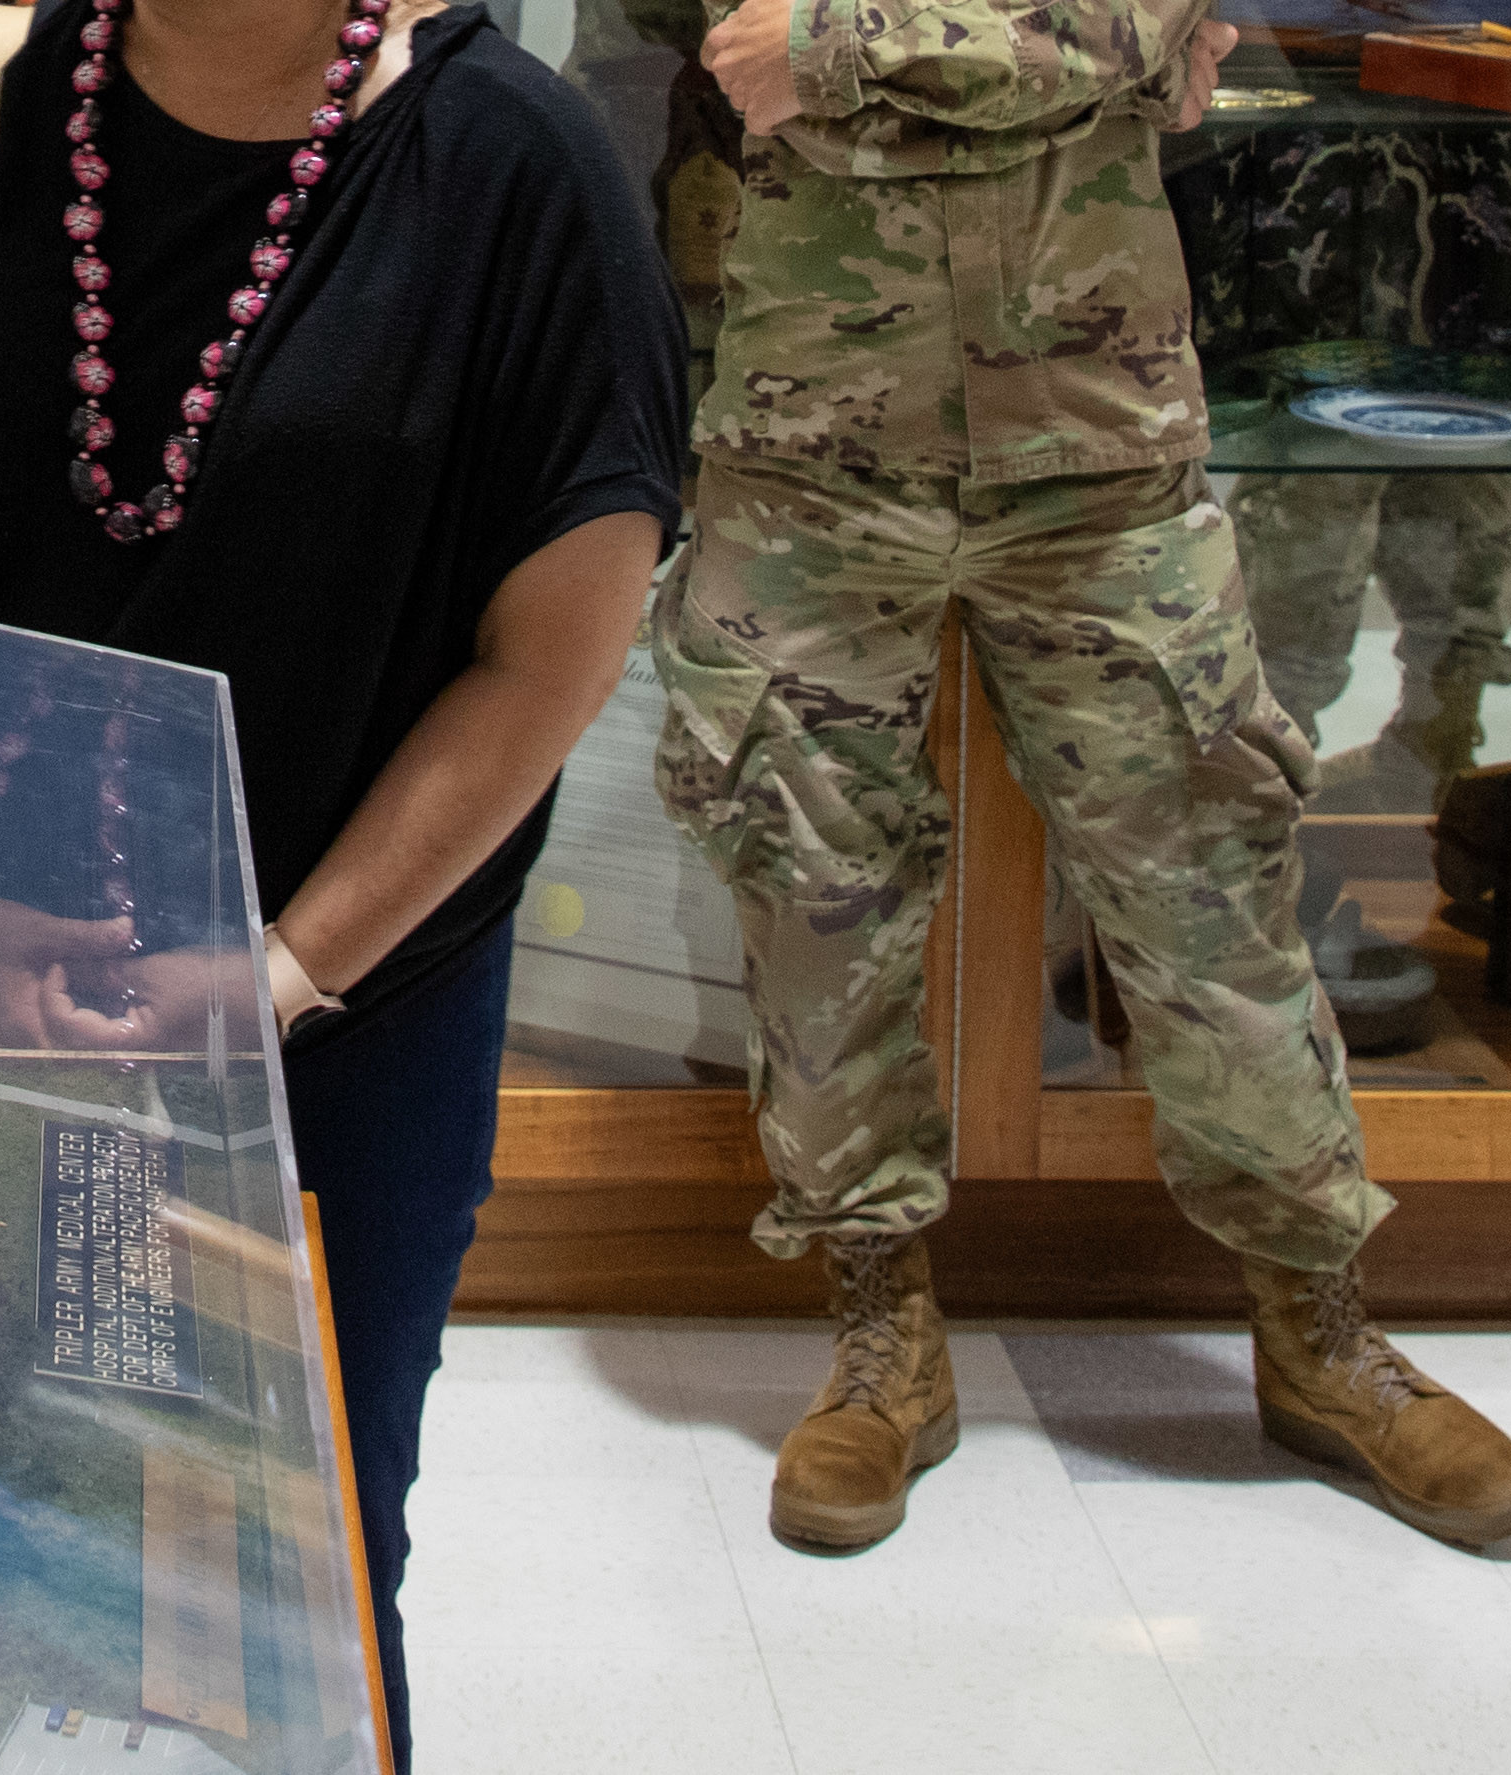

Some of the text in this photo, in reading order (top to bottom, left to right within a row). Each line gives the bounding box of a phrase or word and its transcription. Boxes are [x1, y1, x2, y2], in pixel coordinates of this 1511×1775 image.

[119, 1155, 142, 1192] OCEAN
[119, 1194, 143, 1238] PACIFIC
[146, 1214, 170, 1245] FORT
[54, 1132, 85, 1365] TRIPLER ARMY MEDICAL CENTER
[120, 1238, 145, 1270] ARMY
[121, 1271, 146, 1294] THE
[121, 1294, 147, 1313] OF
[122, 1315, 148, 1352] DEPT.
[151, 1318, 176, 1337] OF
[93, 1315, 118, 1380] HOSPITAL
[152, 1341, 178, 1387] CORPS
[123, 1355, 148, 1384] FOR
